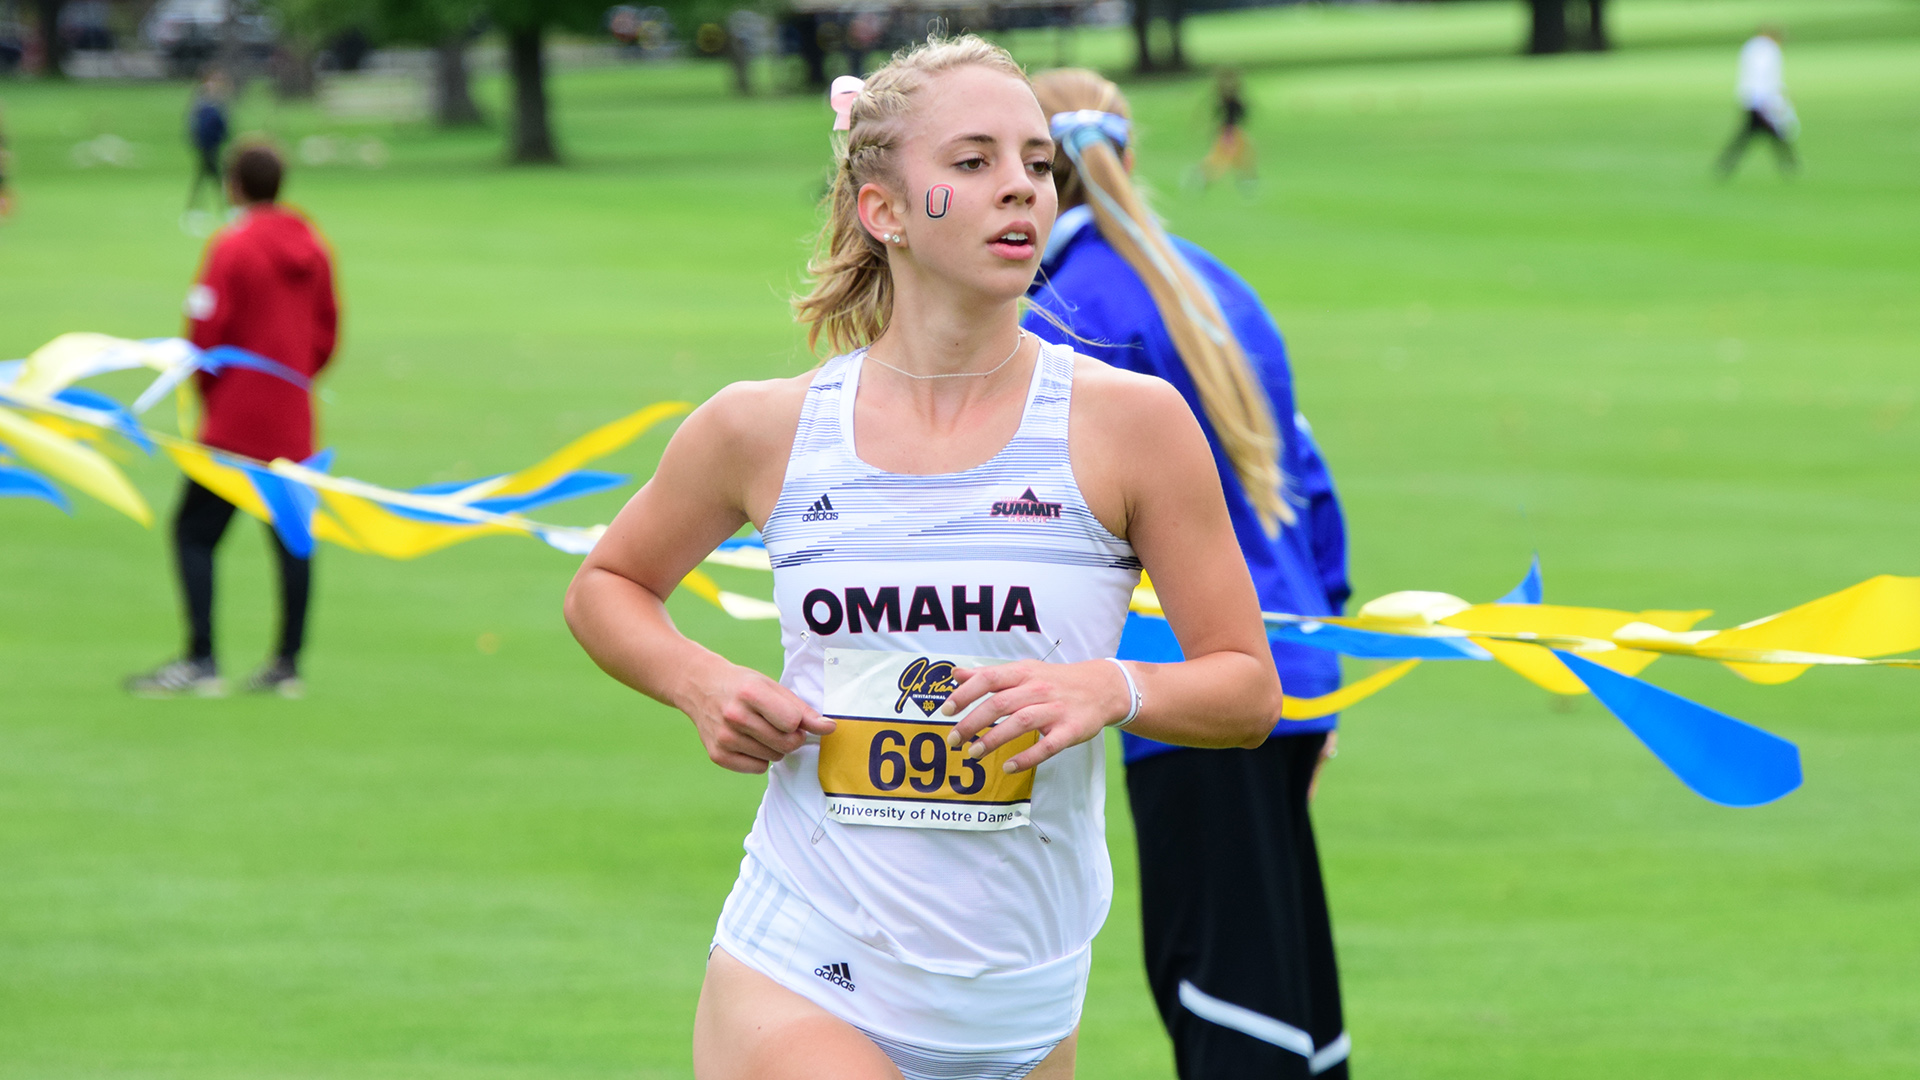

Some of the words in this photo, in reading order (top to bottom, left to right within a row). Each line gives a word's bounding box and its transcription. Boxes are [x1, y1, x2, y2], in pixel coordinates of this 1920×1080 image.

[802, 510, 839, 522] adidas
[990, 502, 1062, 518] SUMMIT
[803, 585, 1041, 636] OMAHA
[868, 730, 986, 794] 693
[832, 803, 906, 821] University
[910, 808, 926, 820] of
[930, 809, 972, 822] Notre
[977, 811, 1013, 823] Dame
[814, 967, 856, 992] adidas
